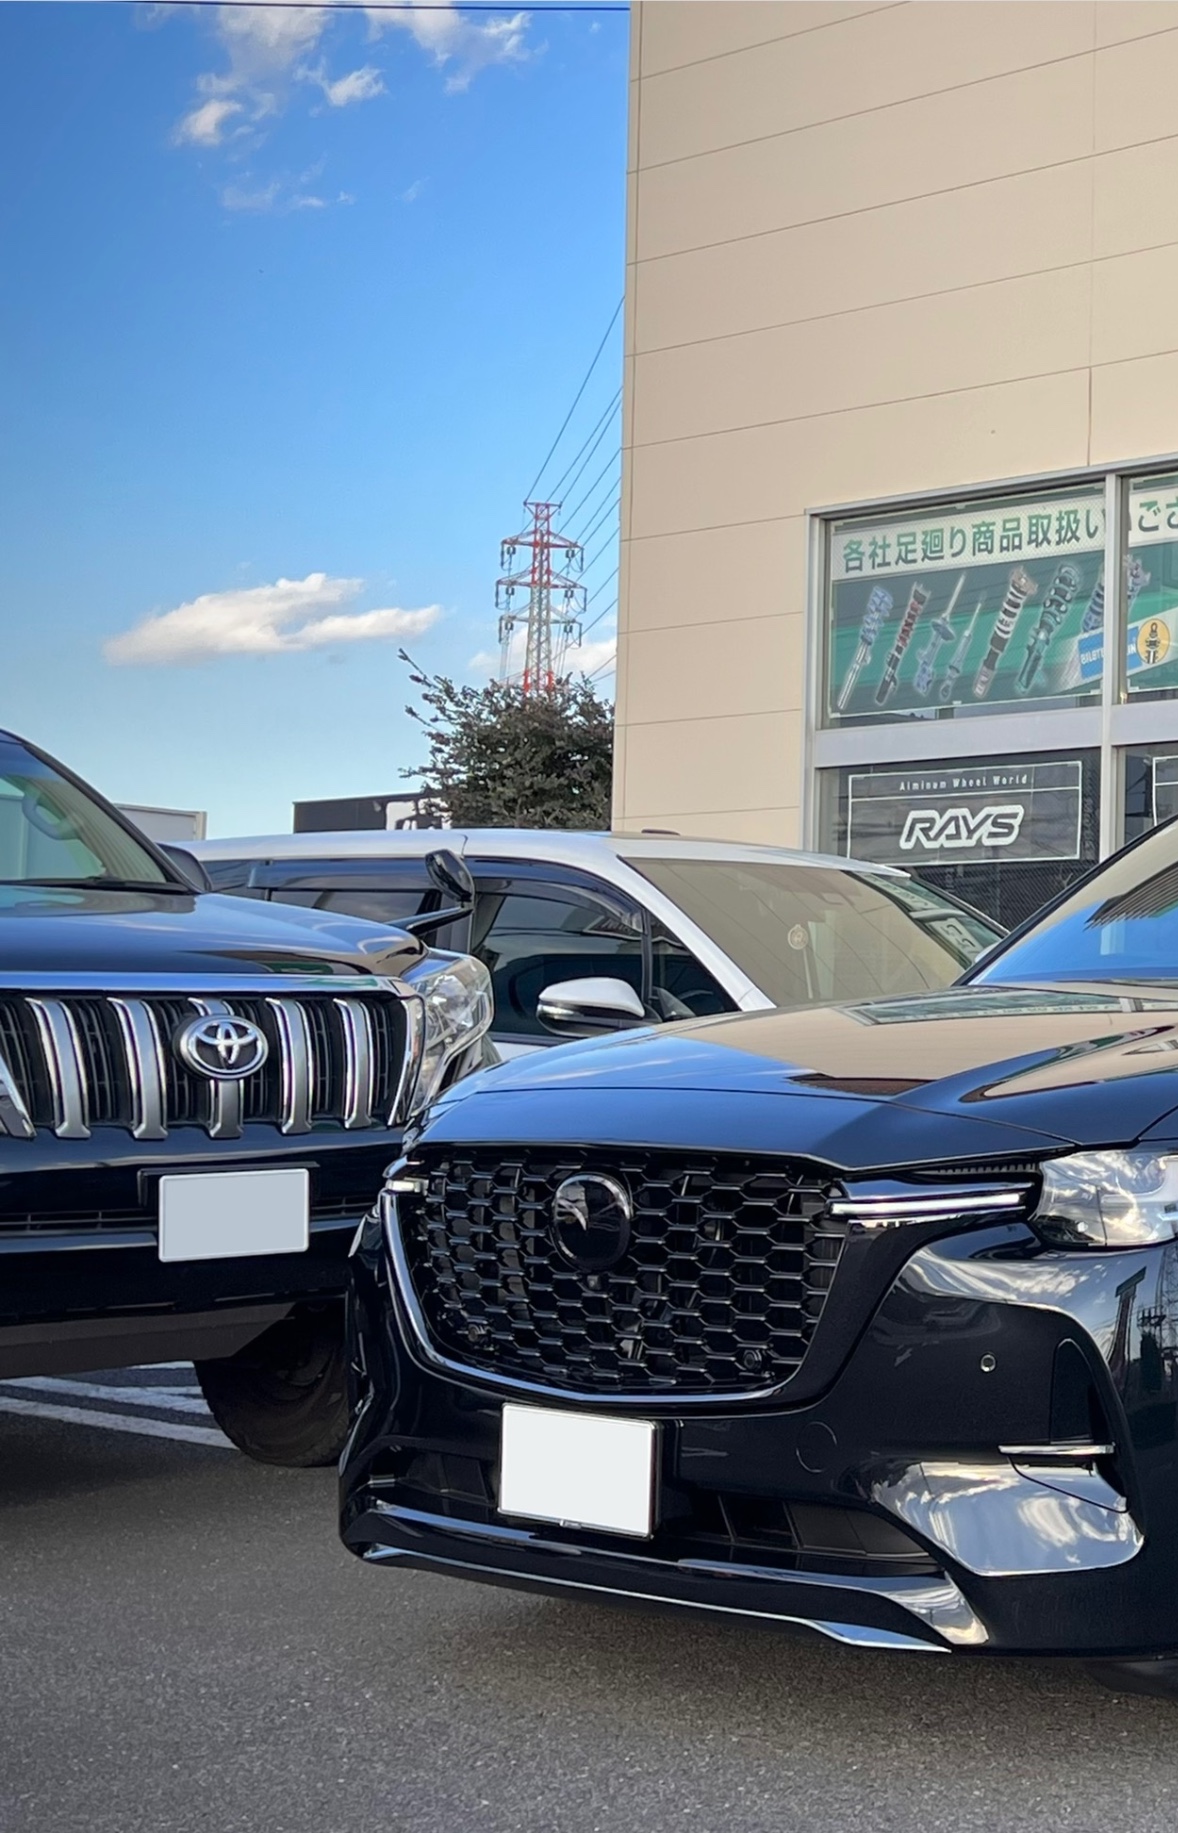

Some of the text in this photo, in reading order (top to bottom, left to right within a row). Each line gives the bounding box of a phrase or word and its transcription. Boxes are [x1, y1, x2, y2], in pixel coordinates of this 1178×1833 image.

[952, 776, 987, 789] Wheel
[992, 773, 1028, 786] World
[899, 804, 1025, 850] RAYS
